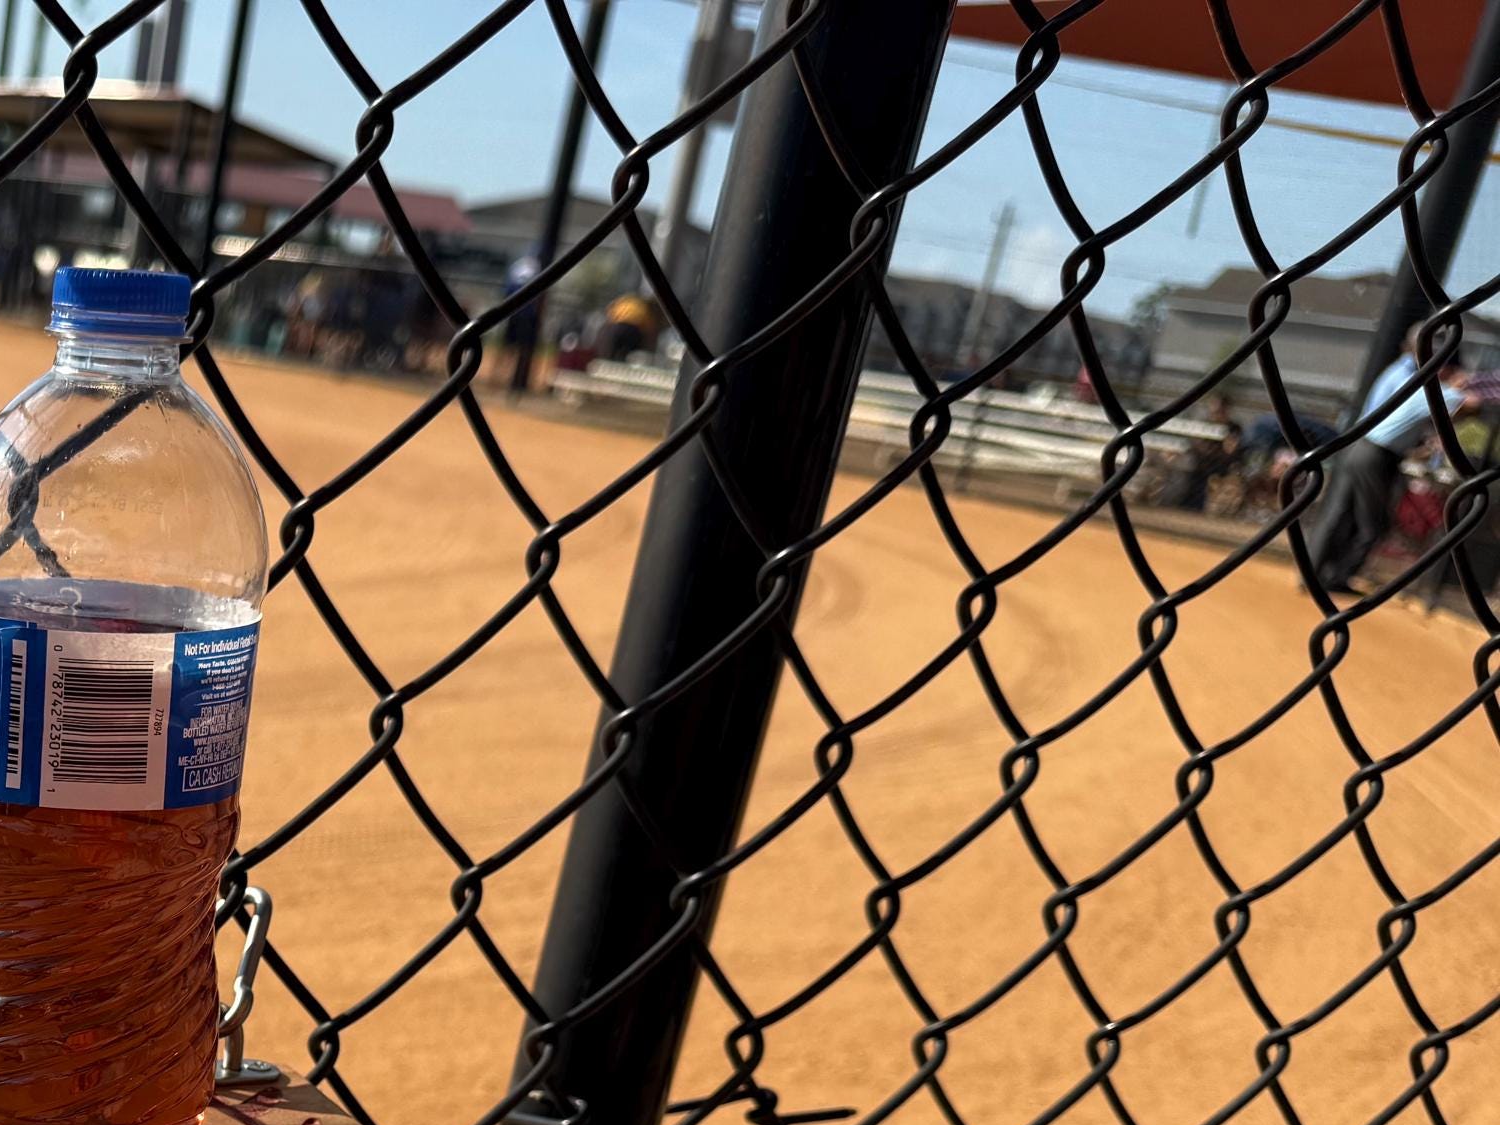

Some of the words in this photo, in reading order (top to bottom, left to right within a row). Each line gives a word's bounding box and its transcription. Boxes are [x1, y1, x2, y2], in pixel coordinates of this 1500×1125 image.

[185, 644, 197, 656] Not
[198, 642, 210, 654] For
[211, 638, 240, 653] Individual
[51, 672, 63, 717] 78742
[201, 706, 212, 717] FOR
[213, 704, 229, 714] WATER
[183, 726, 209, 738] BOTTLED
[210, 723, 226, 734] WATER
[48, 723, 62, 768] 23019
[189, 770, 200, 788] CA
[202, 766, 222, 786] CASH
